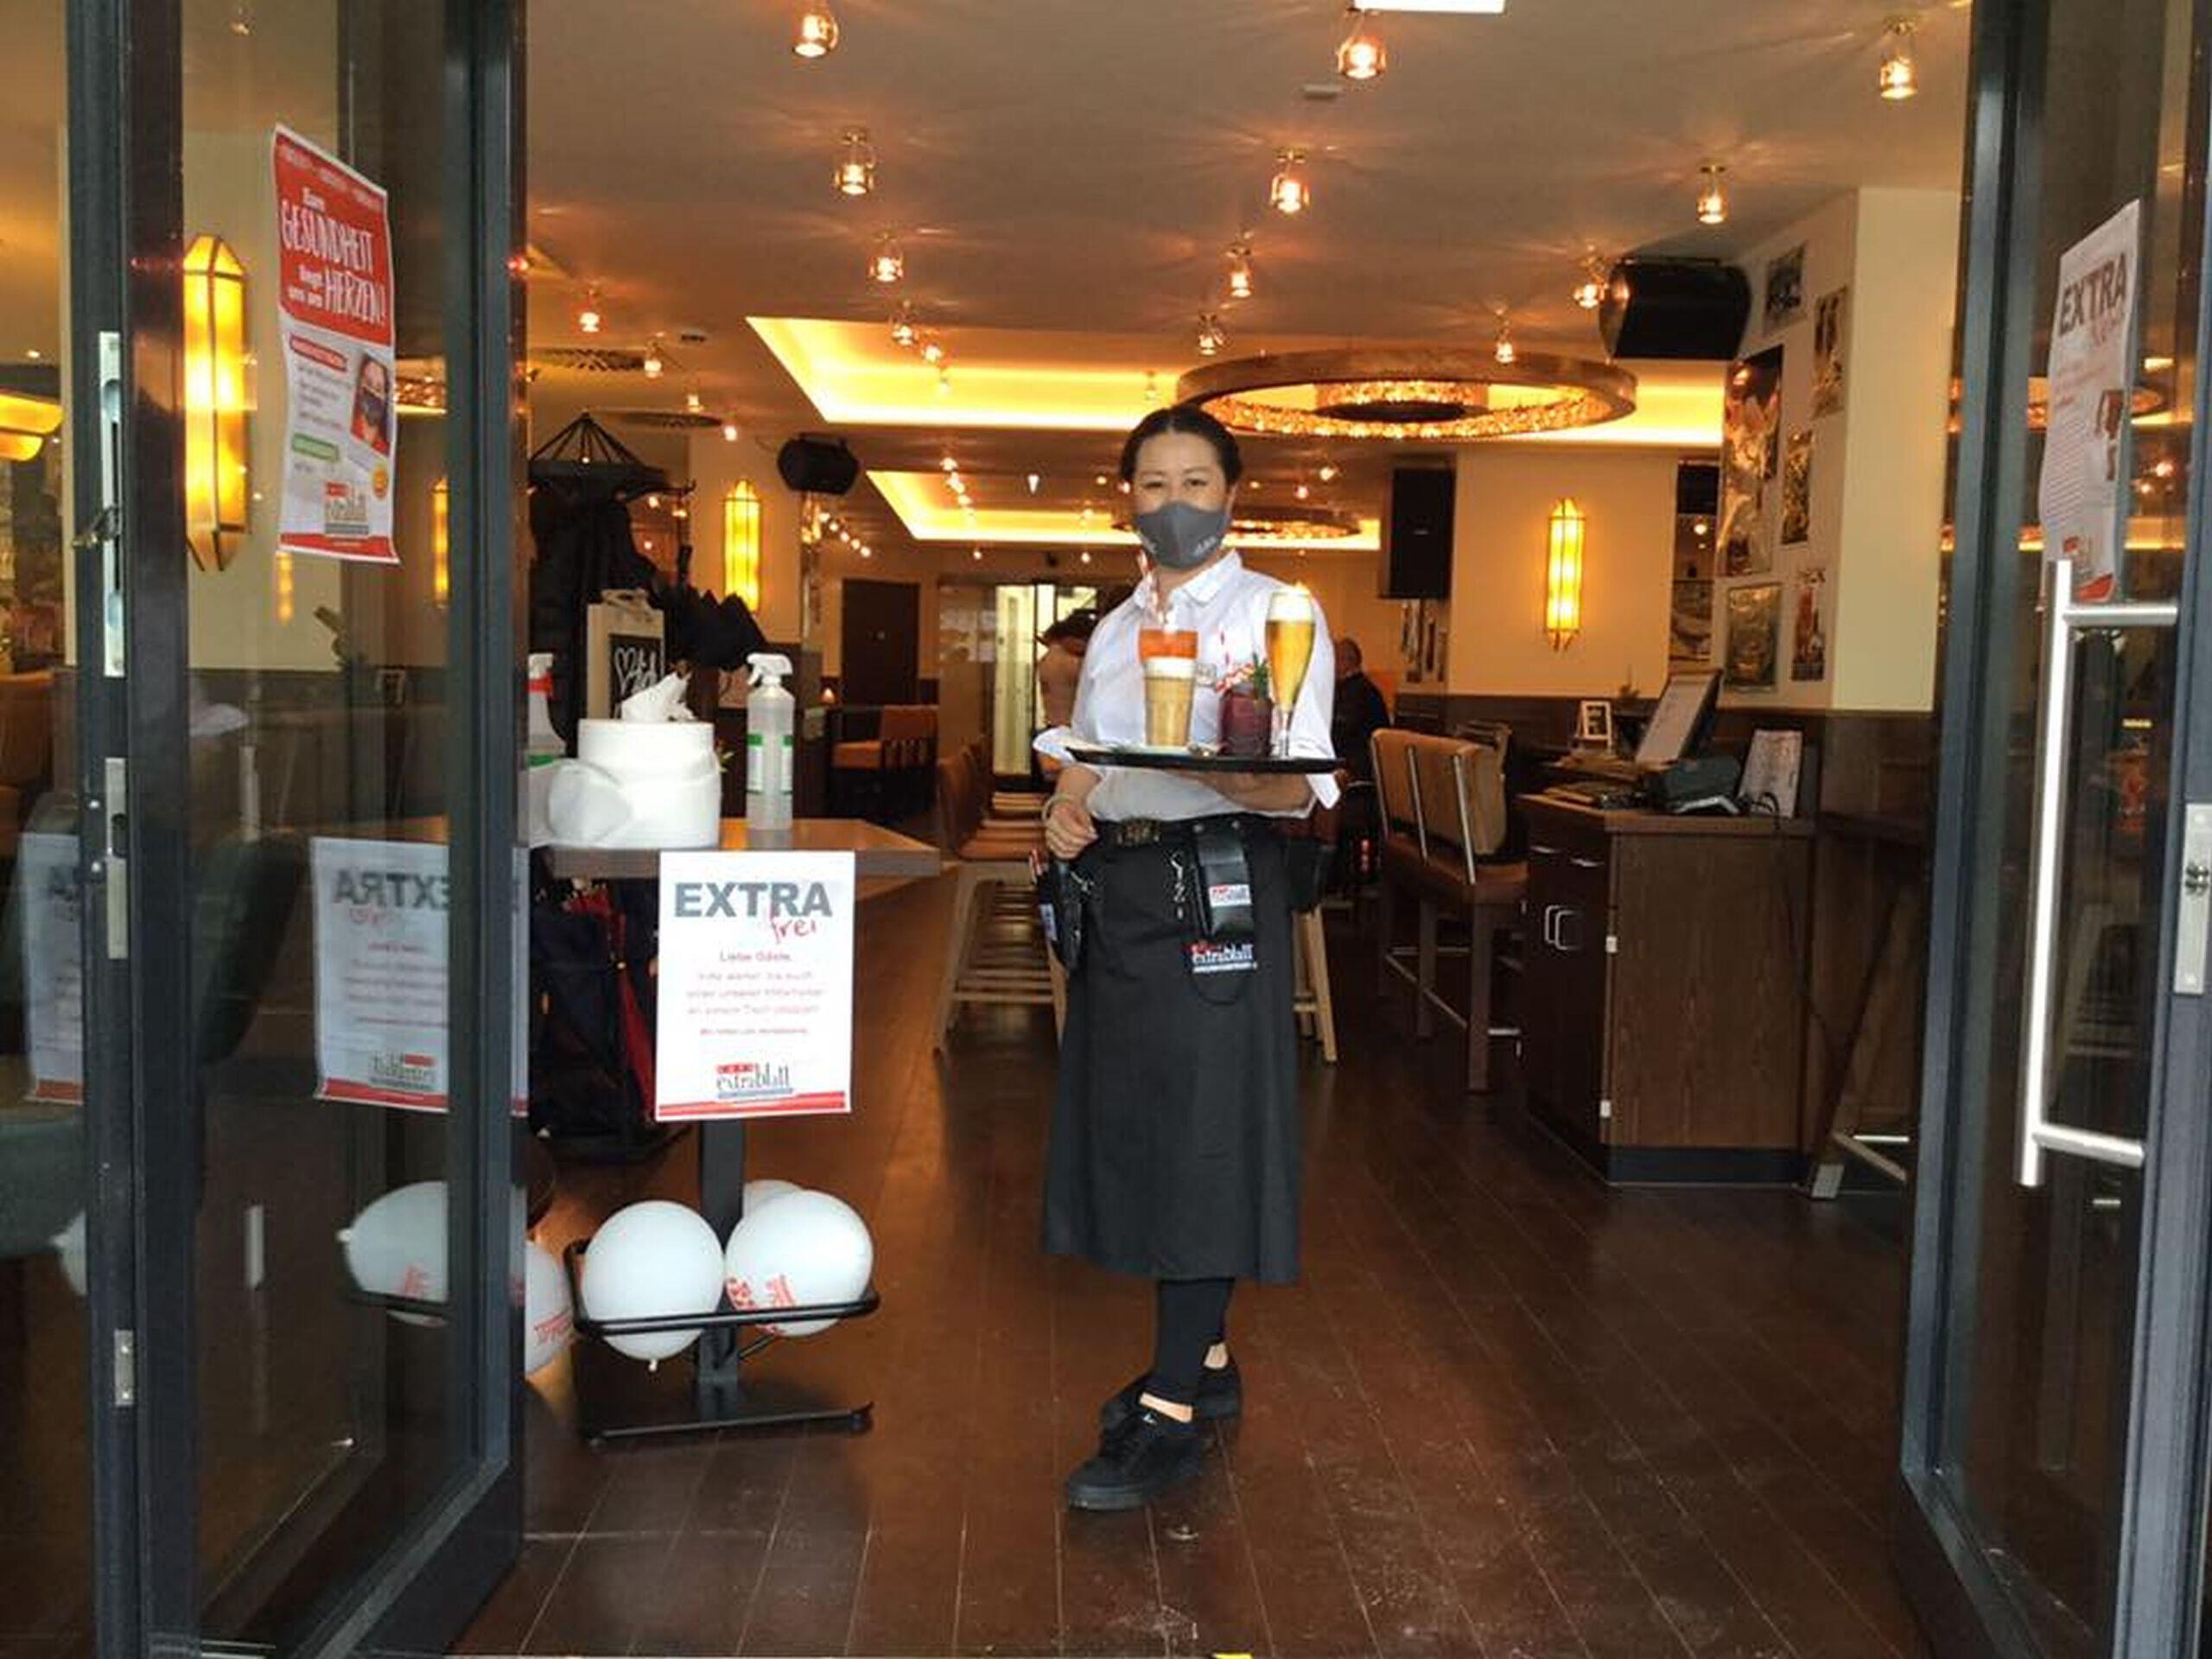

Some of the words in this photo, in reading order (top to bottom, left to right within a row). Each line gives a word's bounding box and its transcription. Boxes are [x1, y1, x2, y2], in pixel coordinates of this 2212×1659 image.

[282, 198, 373, 276] GESUNDHEIT
[2059, 252, 2126, 337] EXTRA
[674, 881, 833, 918] EXTRA
[768, 904, 817, 944] frei
